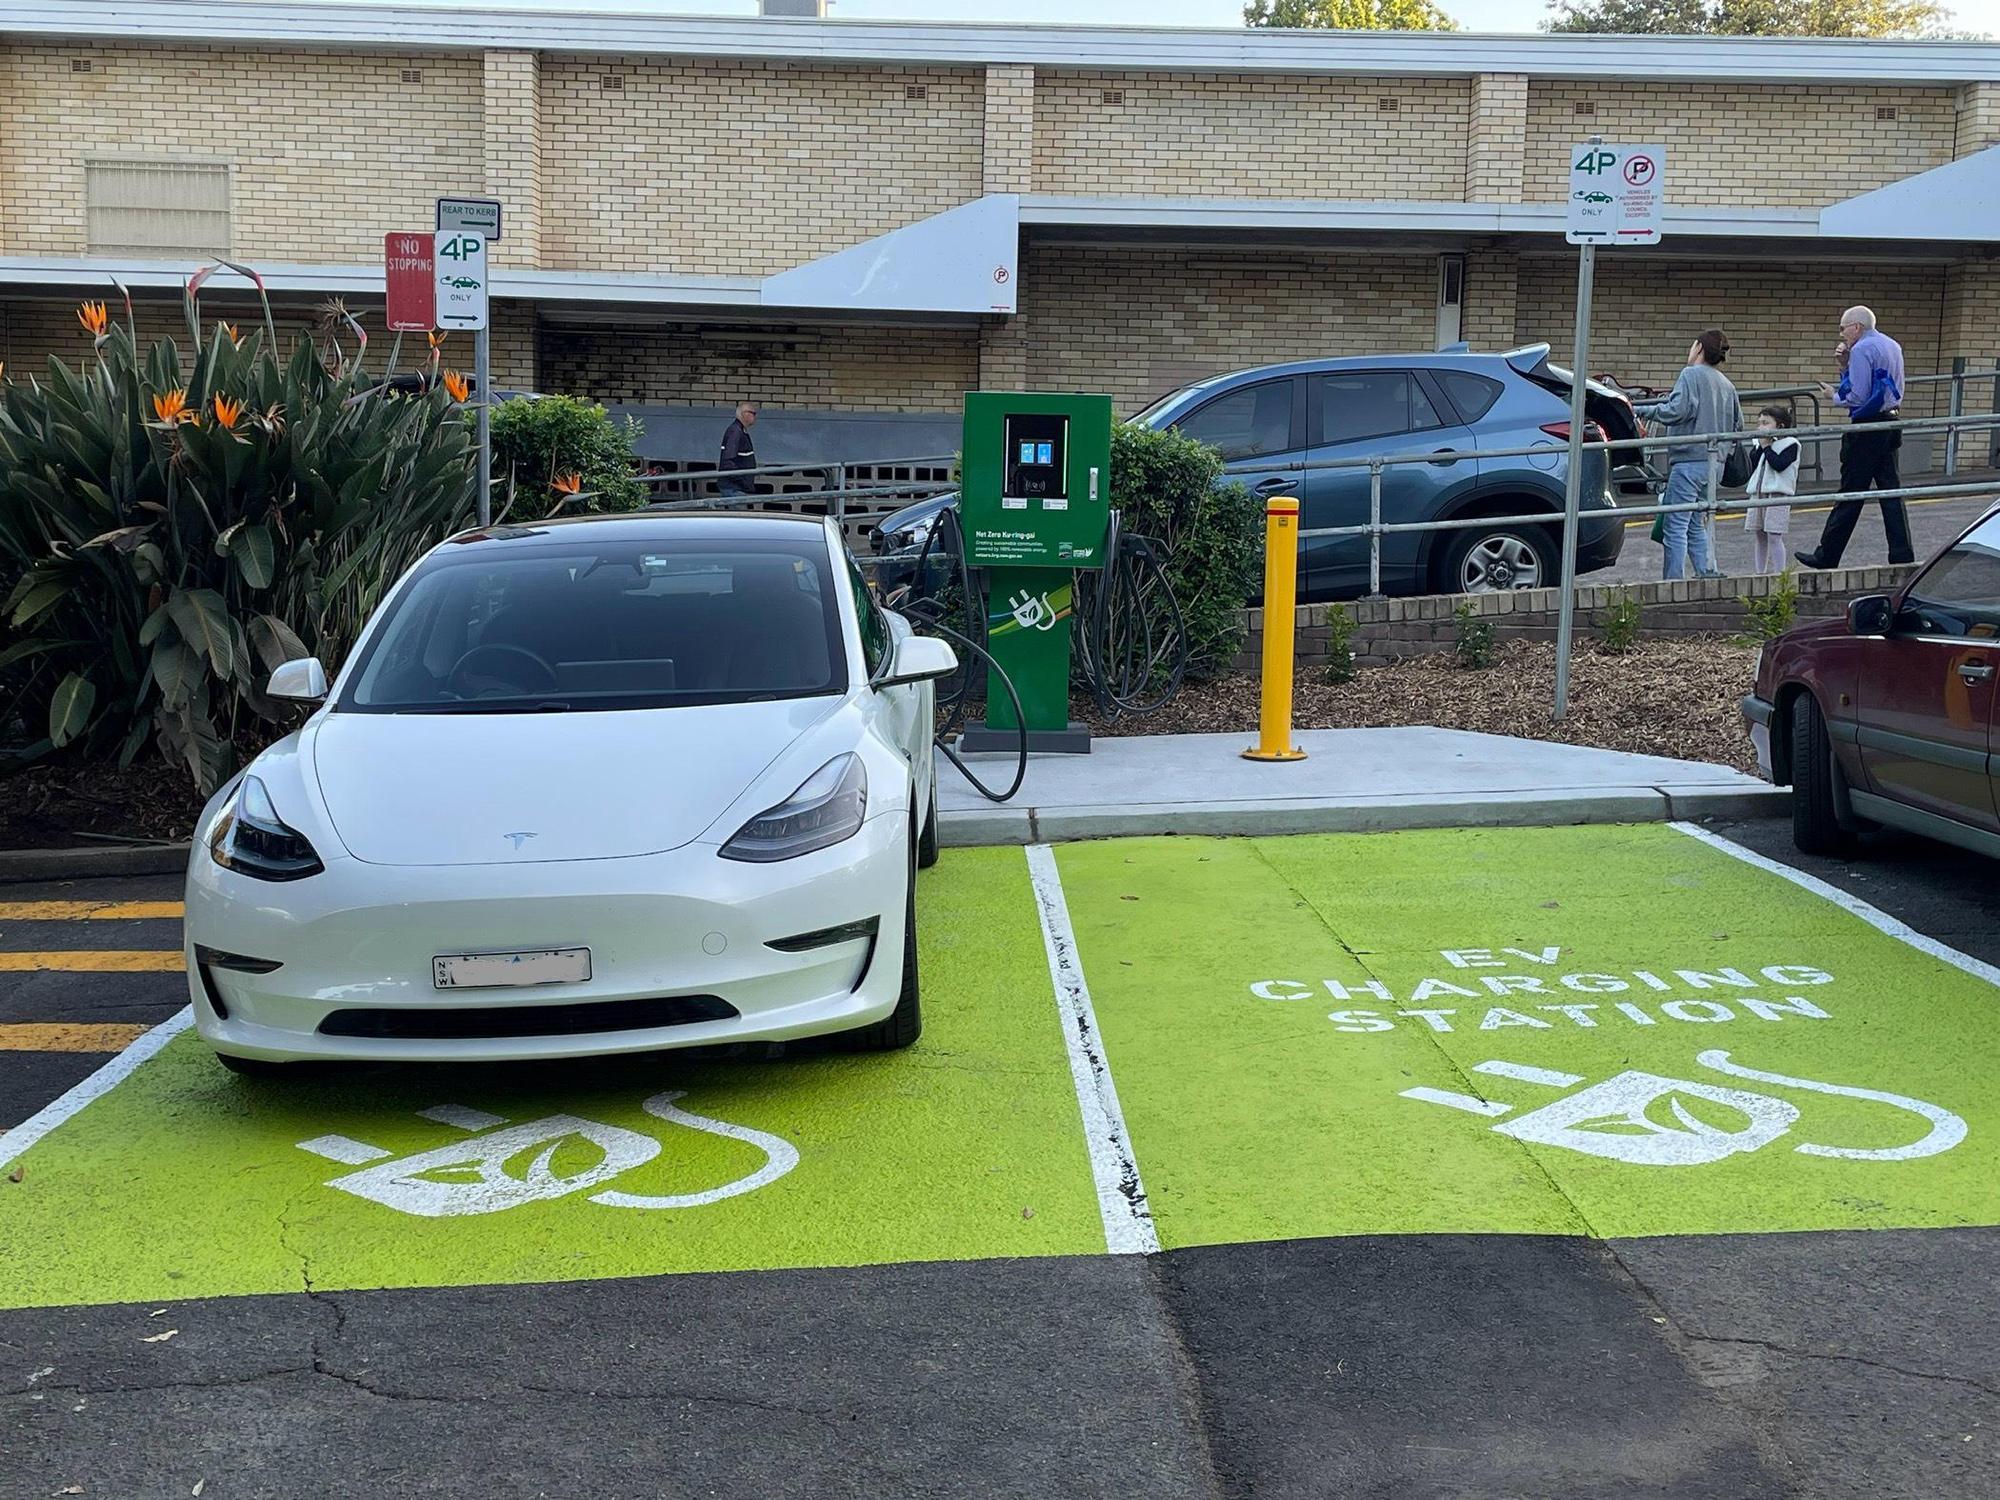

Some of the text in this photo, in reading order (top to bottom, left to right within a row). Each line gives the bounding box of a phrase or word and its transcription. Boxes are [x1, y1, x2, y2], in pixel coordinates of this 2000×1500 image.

[1575, 152, 1616, 175] 4P
[442, 206, 496, 217] REAR TO KERB
[1582, 208, 1602, 216] ONLY
[400, 239, 420, 254] NO
[440, 238, 480, 261] 4P
[389, 258, 433, 271] STOPPING
[1439, 946, 1561, 968] EV
[1250, 965, 1835, 1001] CHARGING
[1327, 996, 1834, 1033] STATION
